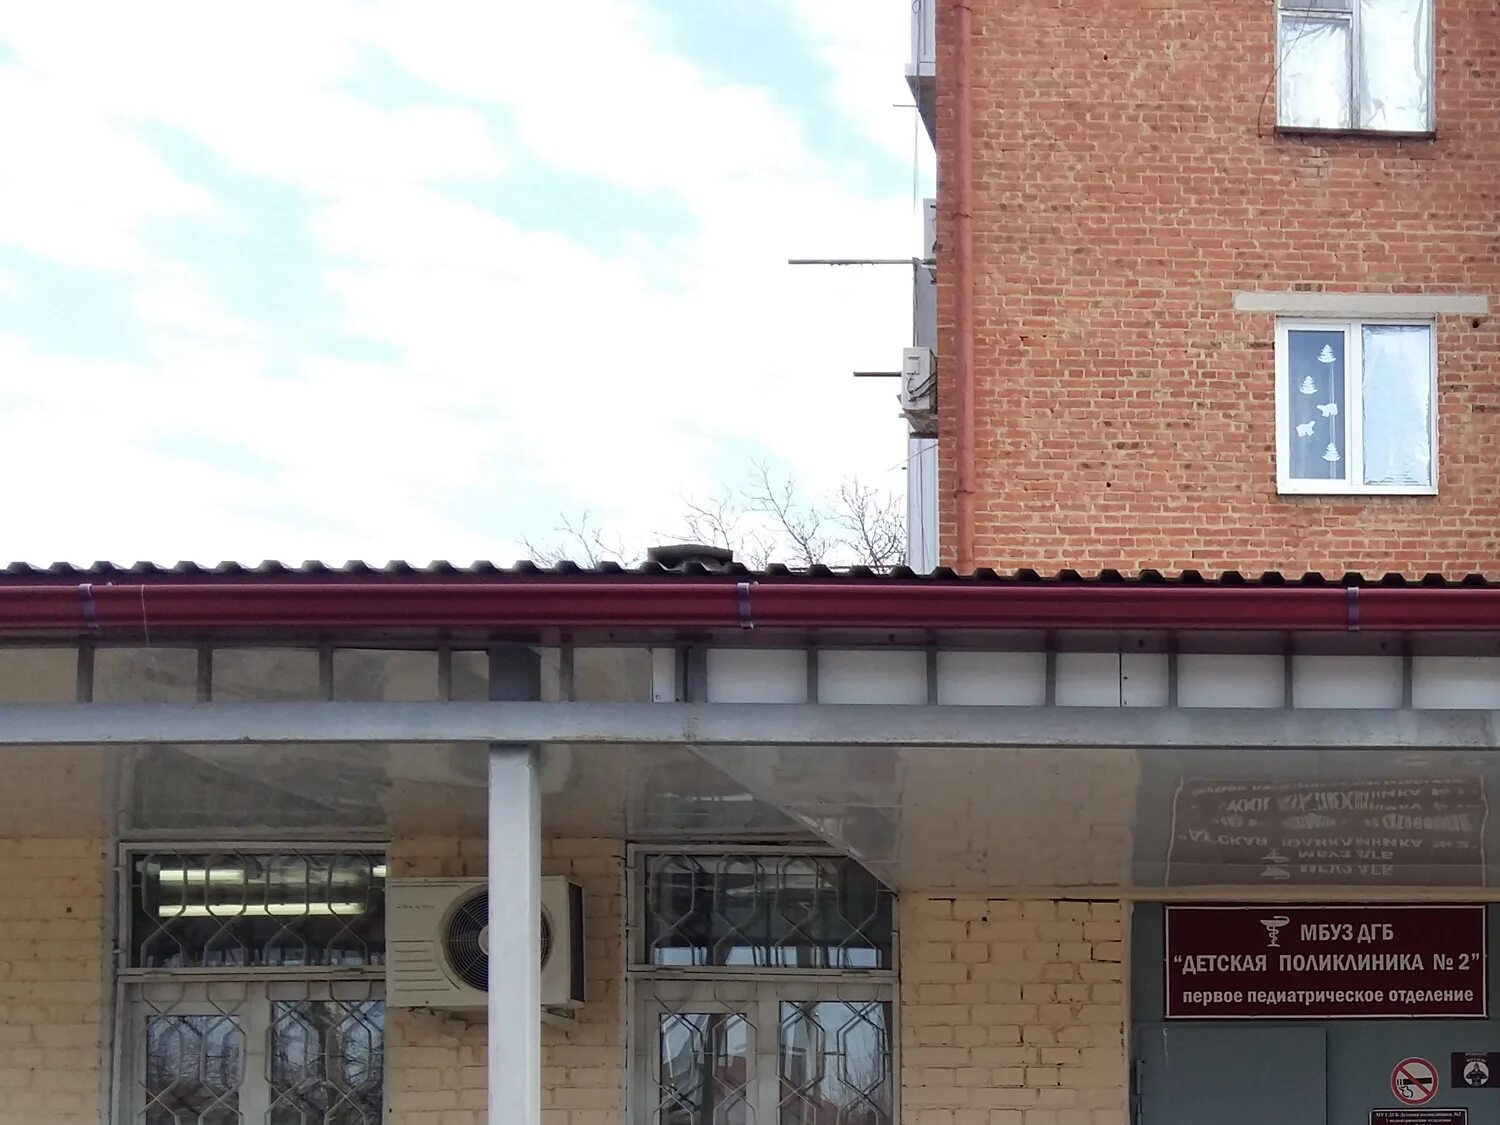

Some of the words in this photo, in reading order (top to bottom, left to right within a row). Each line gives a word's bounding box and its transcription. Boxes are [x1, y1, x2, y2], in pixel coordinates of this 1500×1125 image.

[1300, 924, 1353, 941] МБУЗ
[1357, 924, 1394, 943] ДГБ
[1279, 953, 1424, 971] ПОЛИКЛИНИКА
[1183, 990, 1243, 1006] первое
[1247, 989, 1384, 1005] педиатрическое
[1388, 989, 1474, 1004] отделение
